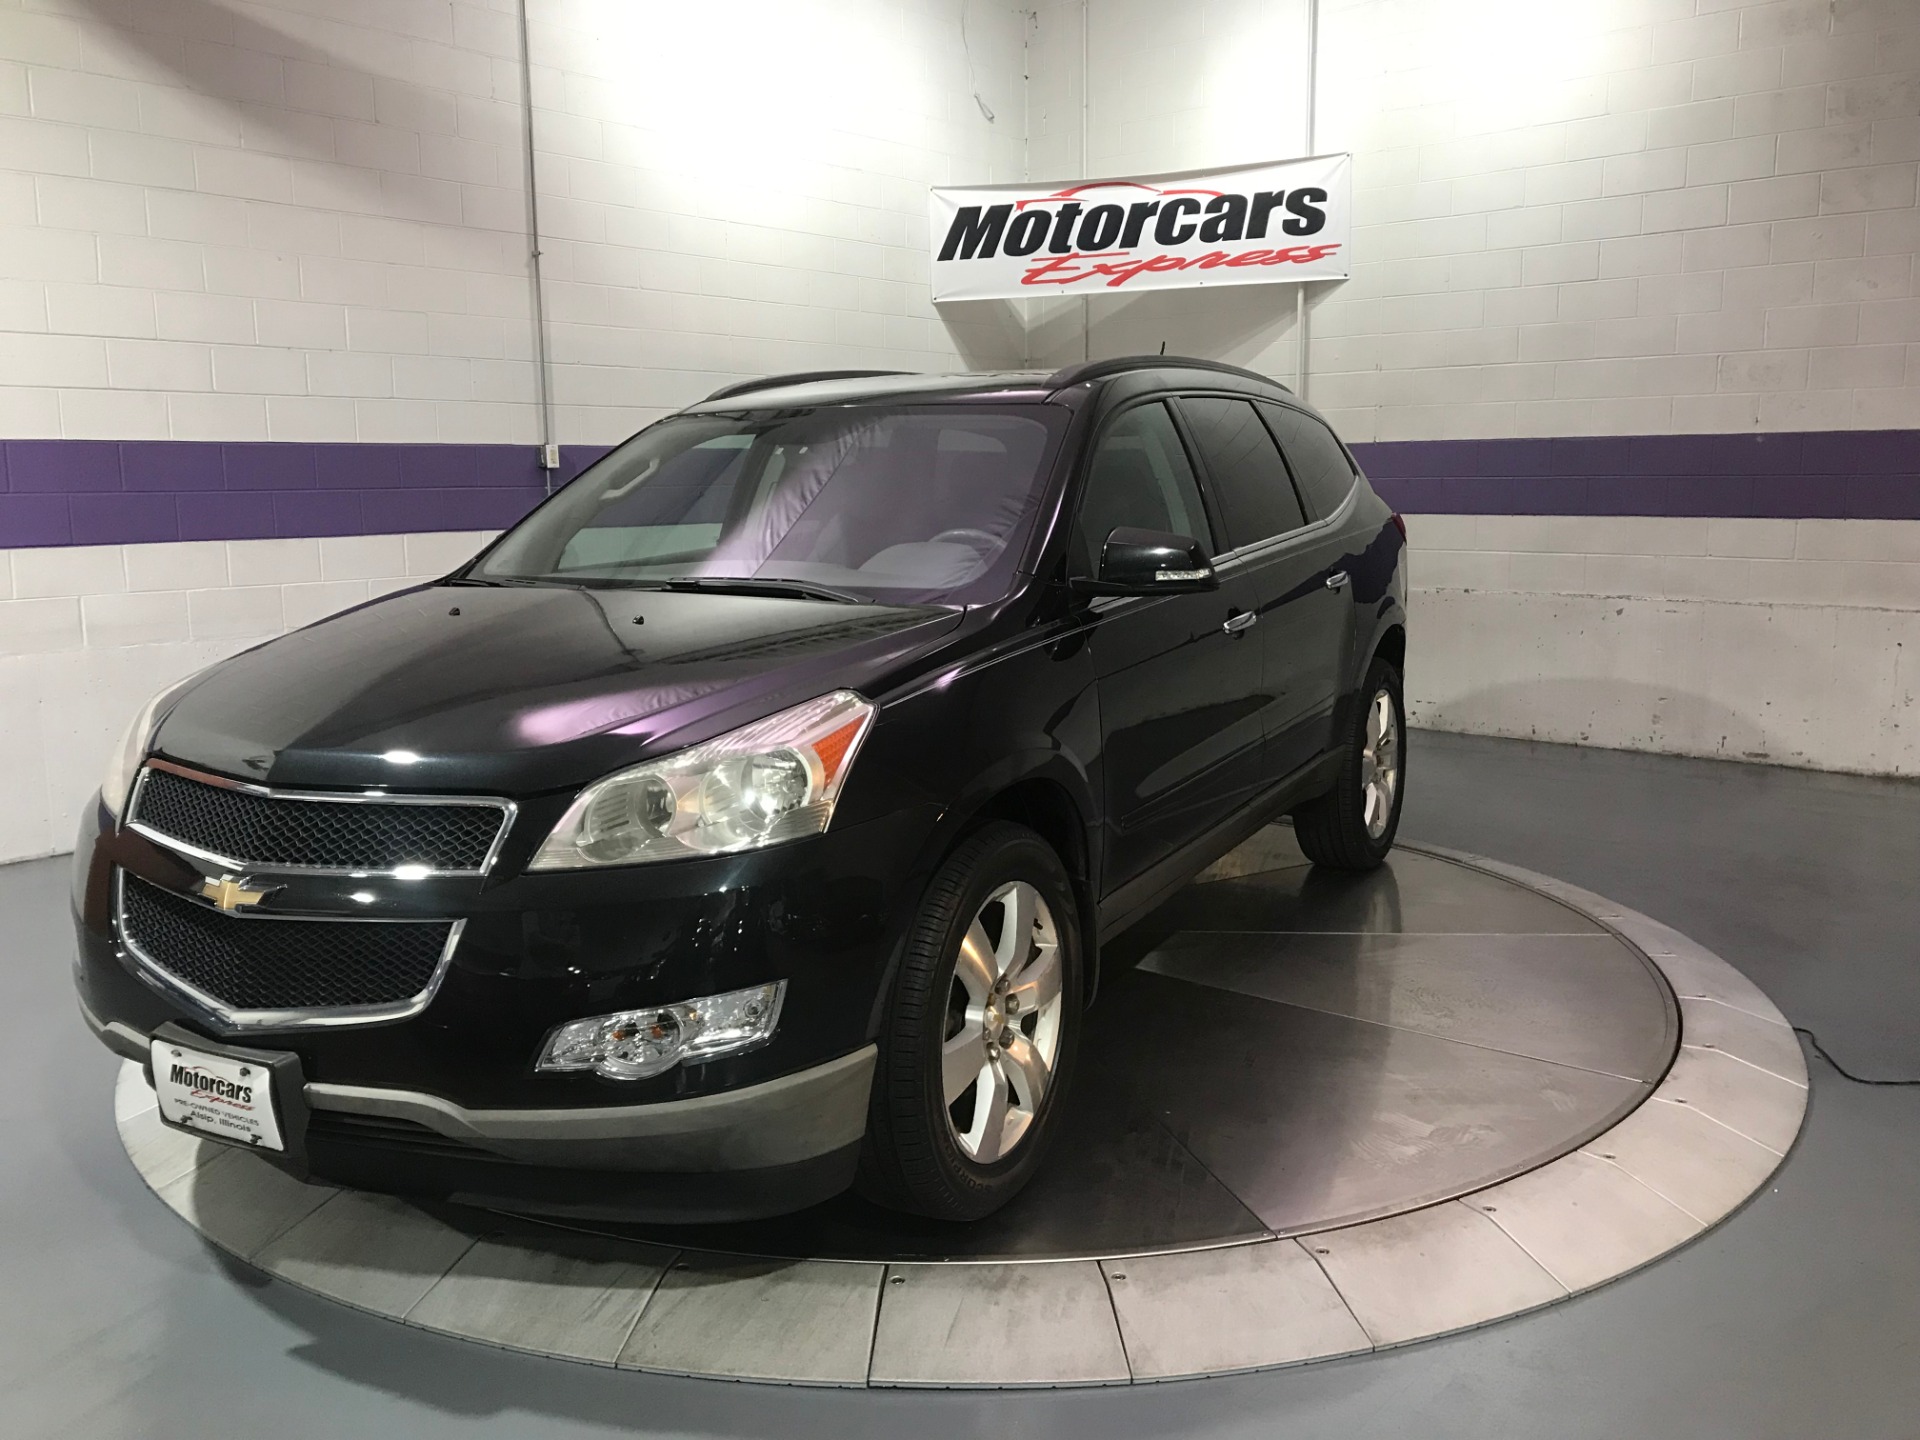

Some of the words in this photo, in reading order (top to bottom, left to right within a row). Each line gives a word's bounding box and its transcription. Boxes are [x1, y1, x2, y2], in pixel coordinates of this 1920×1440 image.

[937, 186, 1328, 262] Motorcars
[1020, 243, 1342, 287] Express
[170, 1064, 252, 1103] Motorcars
[191, 1089, 256, 1111] Express
[190, 1110, 217, 1125] Alsip,
[219, 1118, 252, 1132] Illinois
[222, 1111, 260, 1126] VEHICLES
